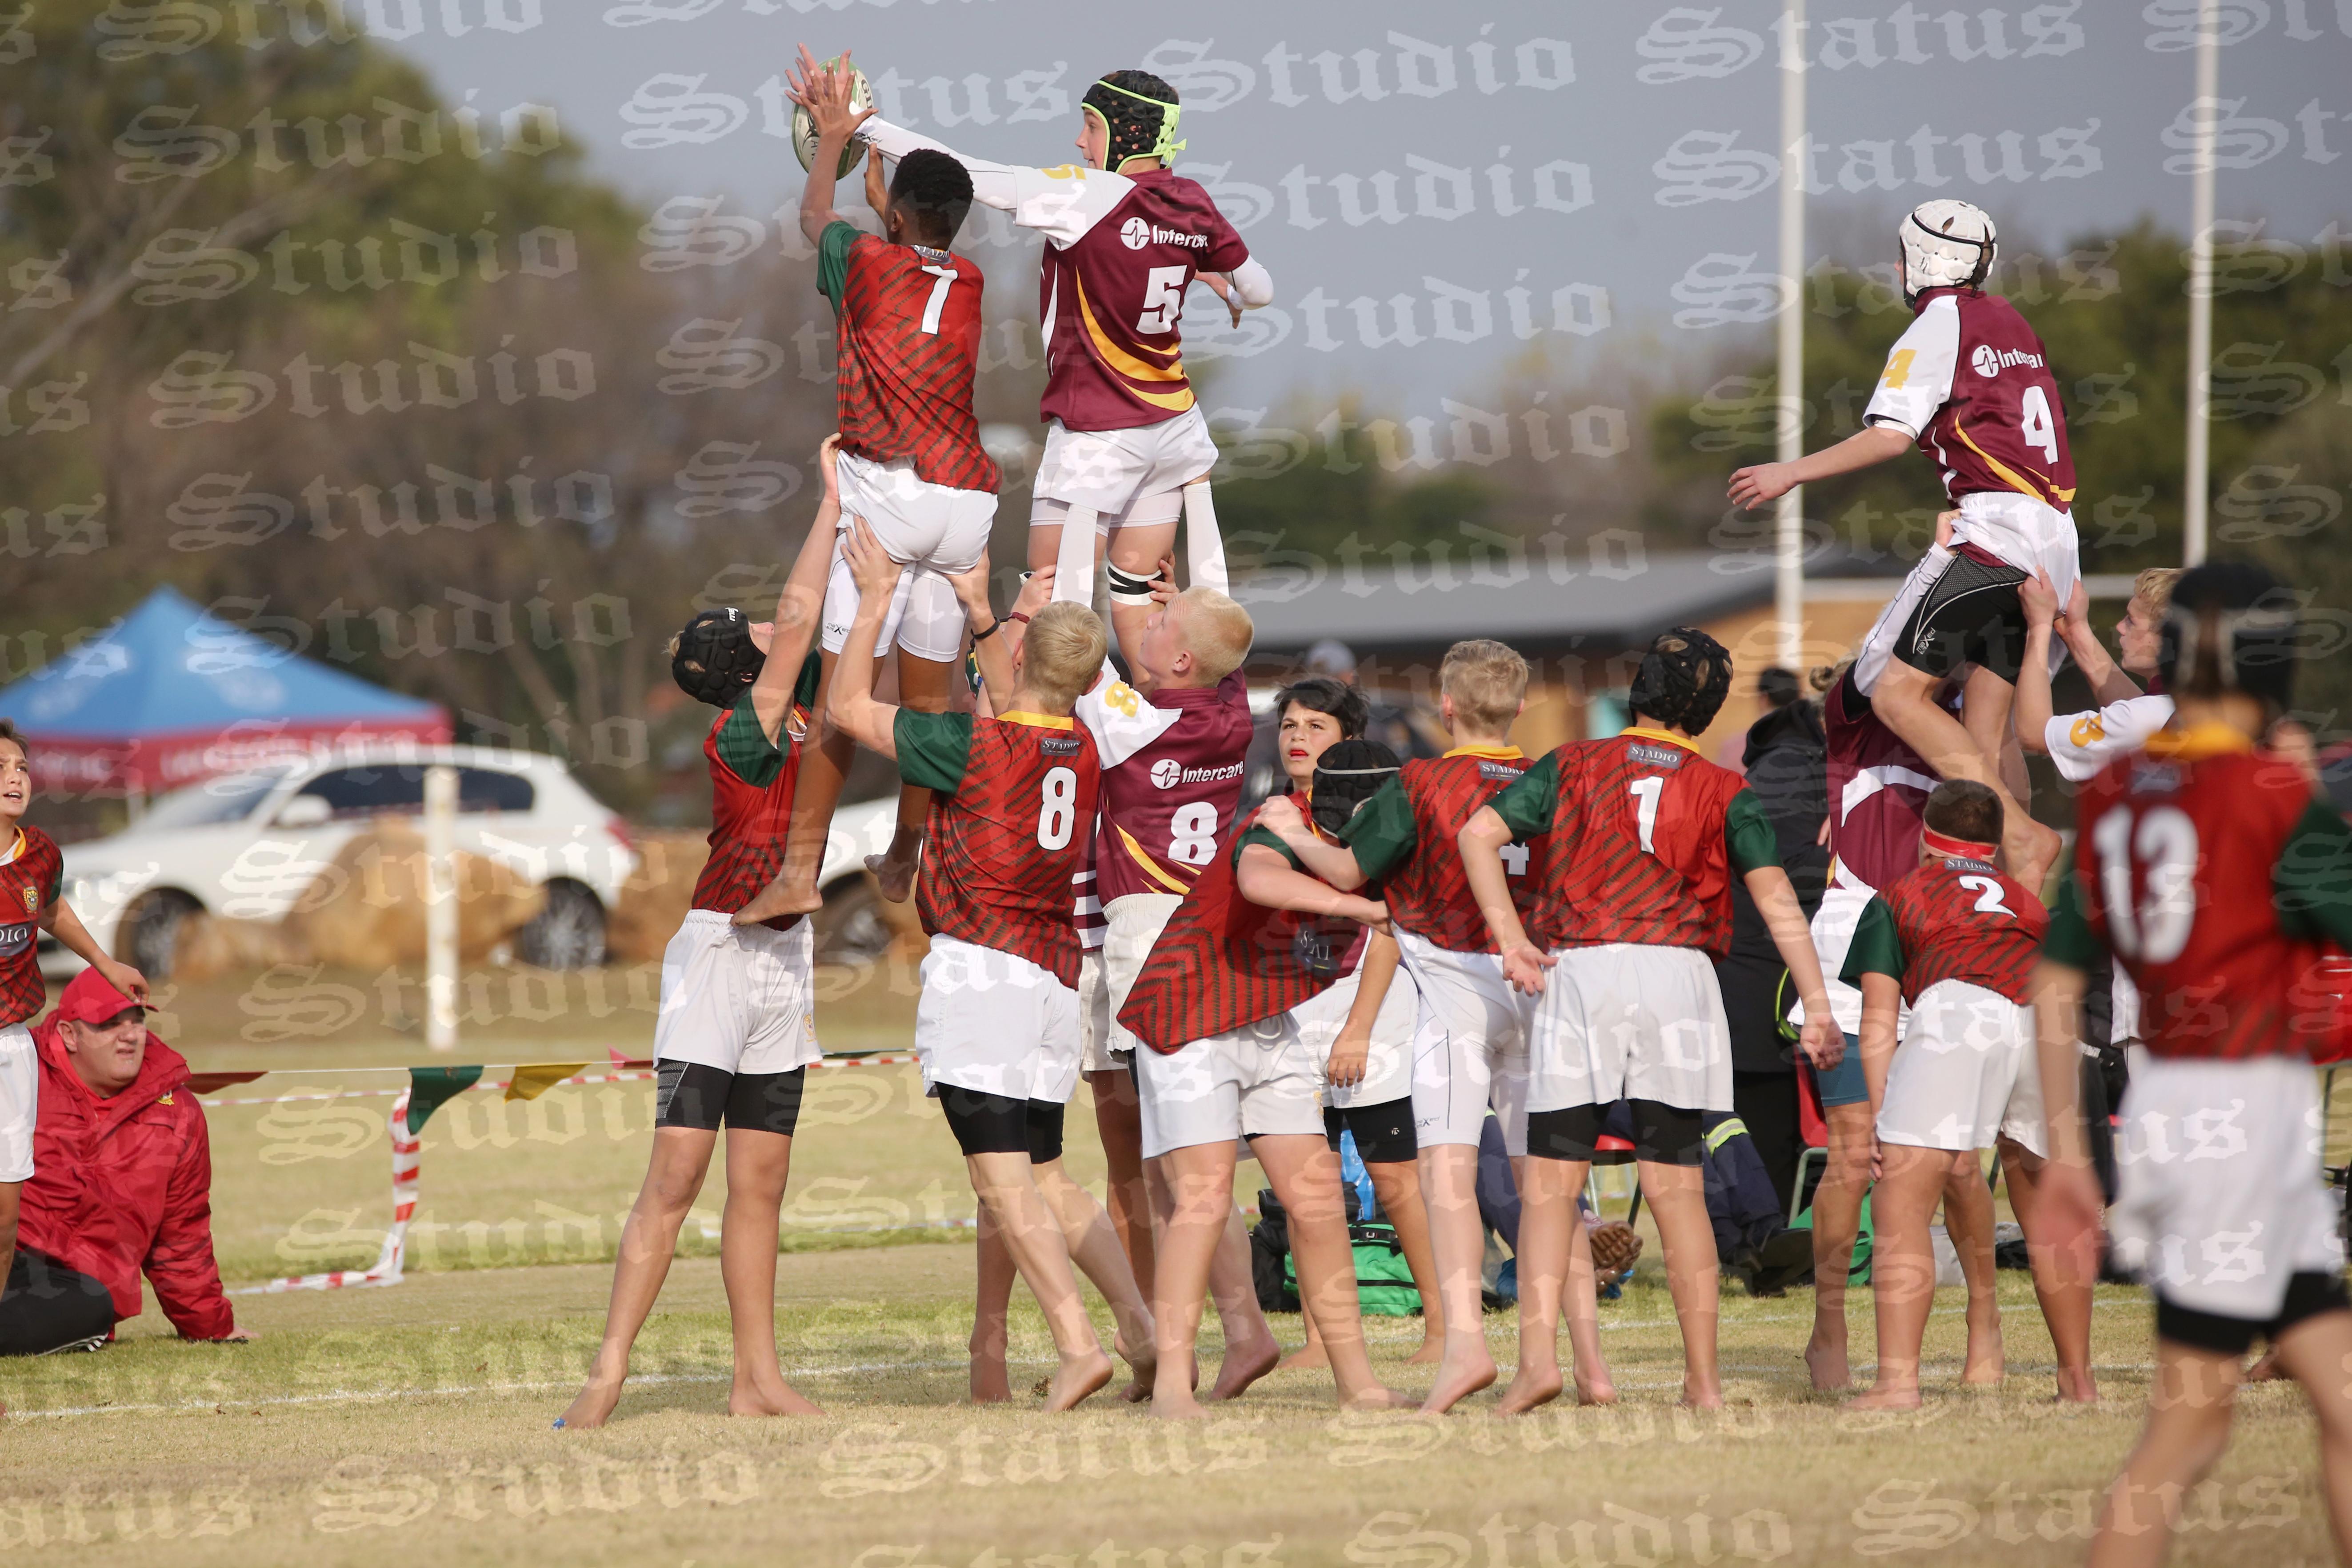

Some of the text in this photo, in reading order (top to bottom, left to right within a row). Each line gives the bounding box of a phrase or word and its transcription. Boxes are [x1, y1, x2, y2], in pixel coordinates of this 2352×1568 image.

[921, 265, 958, 335] 7
[1136, 265, 1187, 334] 5
[1880, 348, 1917, 390] 4
[2021, 385, 2058, 464] 4
[1105, 680, 1138, 718] 8
[1182, 761, 1244, 783] Intercare
[1632, 747, 1677, 762] STADIO
[1037, 766, 1077, 850] 8
[1168, 801, 1218, 865] 8
[1630, 776, 1665, 855] 1
[1959, 876, 2017, 918] 2
[2092, 804, 2199, 964] 13
